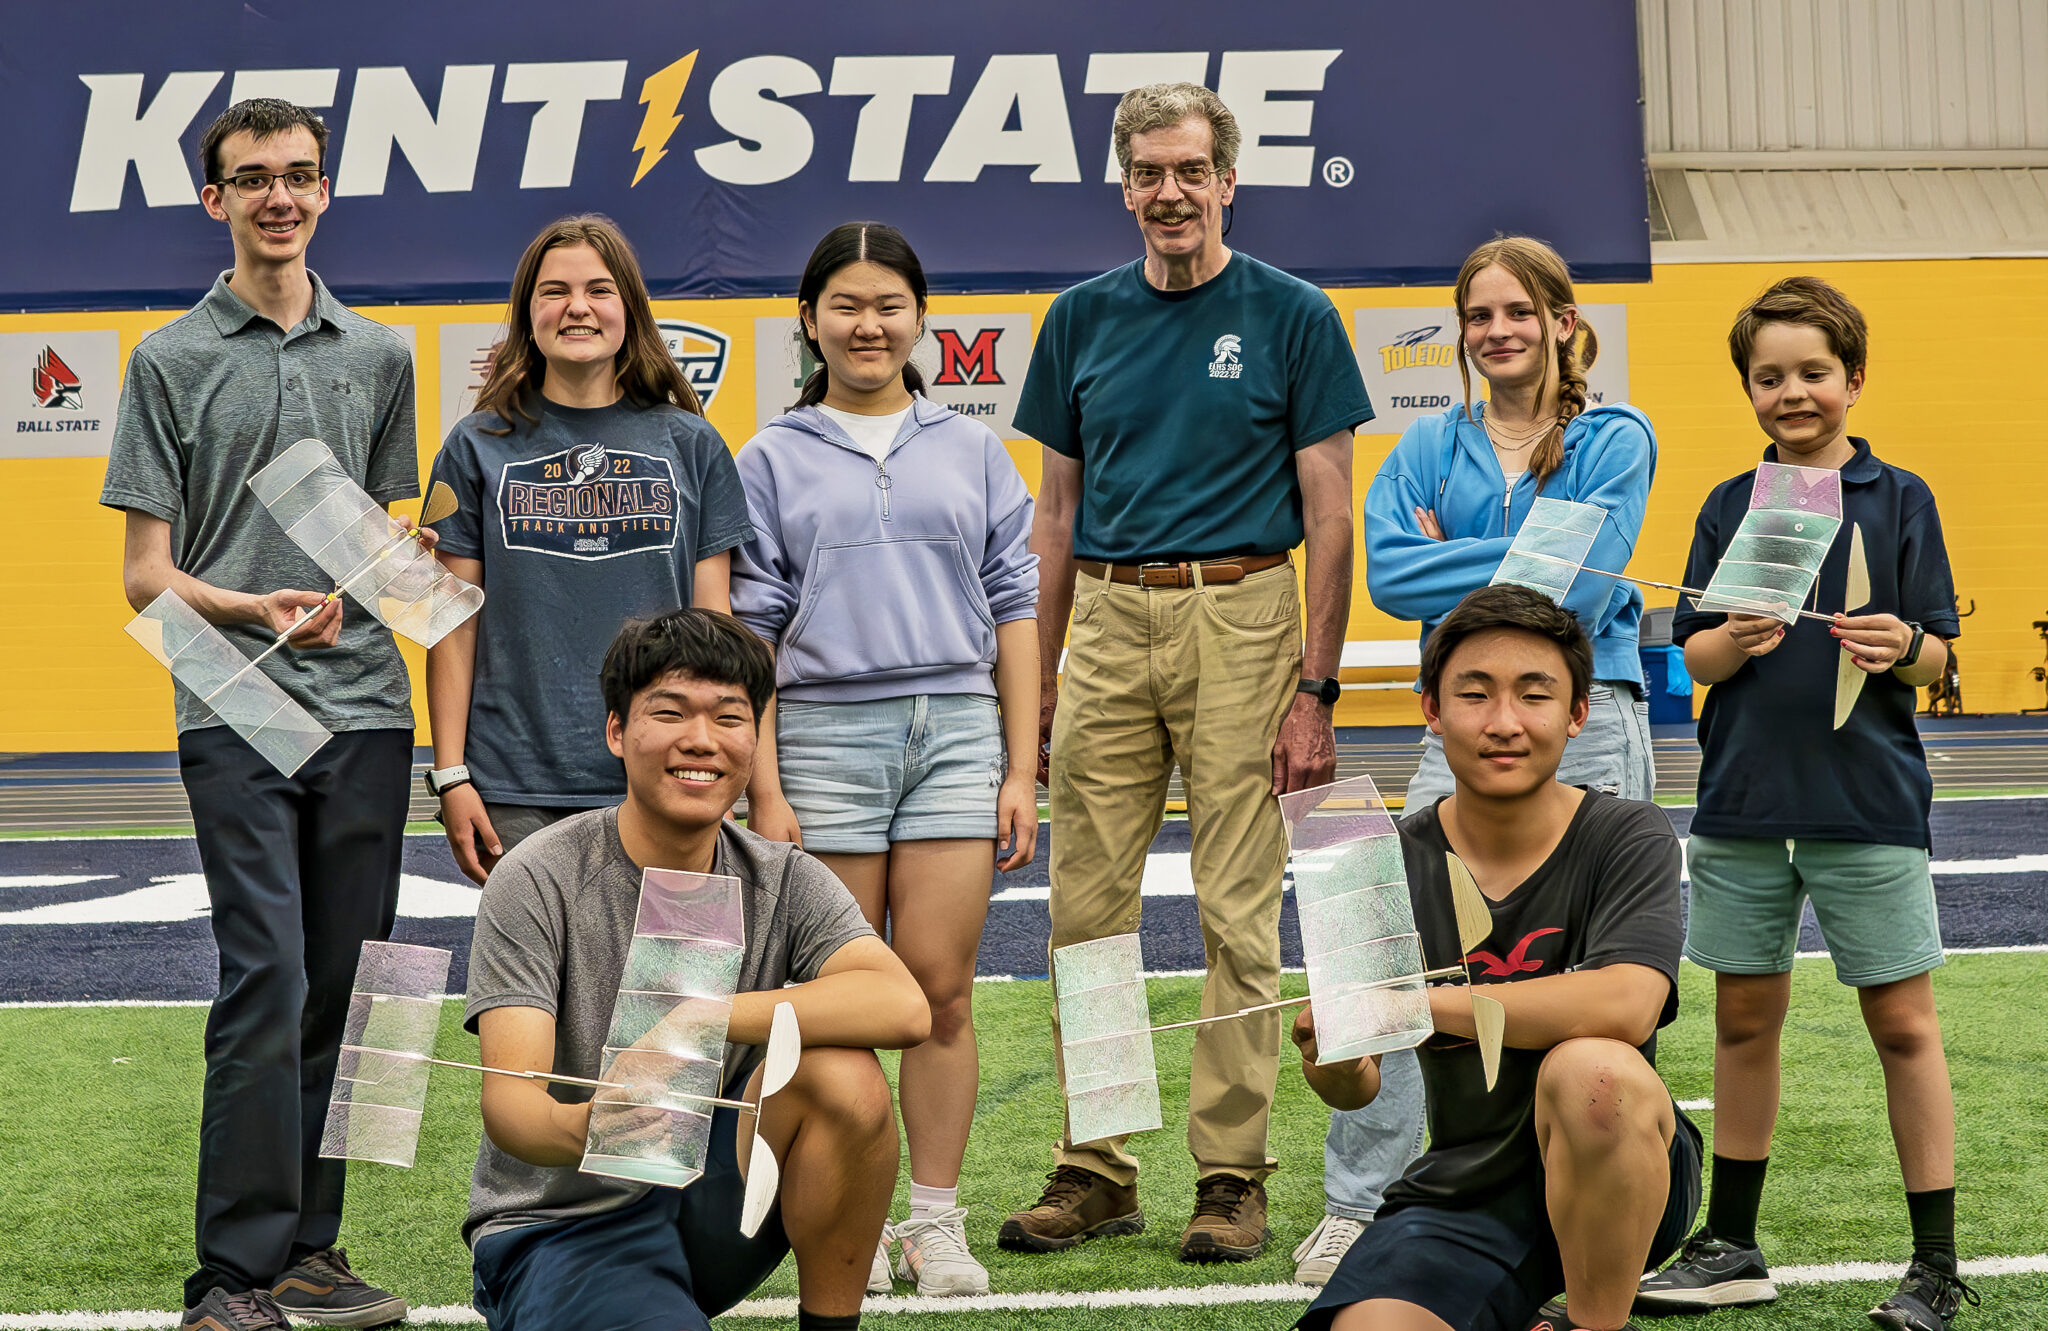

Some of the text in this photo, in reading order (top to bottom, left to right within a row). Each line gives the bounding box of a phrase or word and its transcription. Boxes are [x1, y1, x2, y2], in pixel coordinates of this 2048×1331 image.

[931, 327, 1006, 386] M
[1378, 342, 1455, 375] TOLEDO
[1208, 369, 1242, 379] 2022-23
[947, 403, 997, 416] MIAMI
[1391, 395, 1451, 408] TOLEDO
[16, 419, 101, 433] BALL STATE
[543, 459, 631, 479] 20 22
[508, 482, 672, 519] REGIONALS
[512, 518, 671, 534] TRACK AND FIELD
